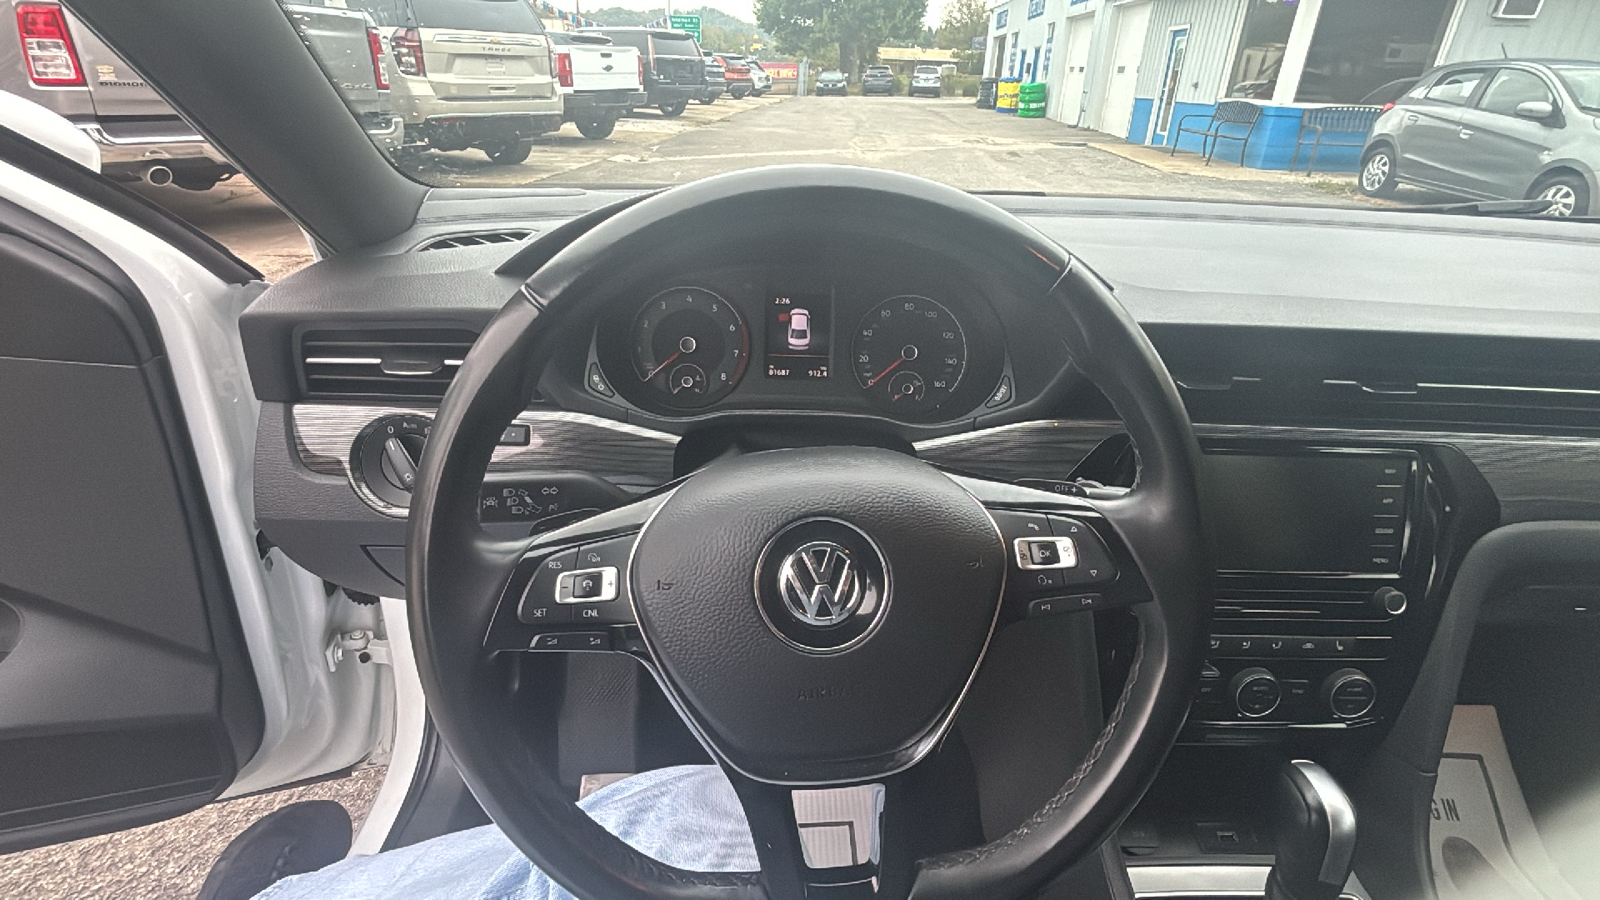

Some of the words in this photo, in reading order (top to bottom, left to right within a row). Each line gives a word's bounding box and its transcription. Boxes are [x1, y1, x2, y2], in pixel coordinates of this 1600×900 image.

[774, 297, 791, 305] 2:26
[660, 301, 666, 310] 3
[712, 304, 718, 312] 5
[904, 303, 915, 311] 80
[880, 309, 891, 317] 60
[733, 349, 739, 358] 7
[859, 354, 869, 362] 20
[944, 357, 958, 365] 140
[720, 372, 727, 380] 8
[934, 380, 946, 388] 160
[1054, 484, 1069, 493] OFF
[1039, 549, 1051, 558] OK
[548, 561, 562, 569] RES
[533, 608, 547, 617] SET
[582, 608, 599, 618] CNL
[1441, 798, 1460, 820] IN
